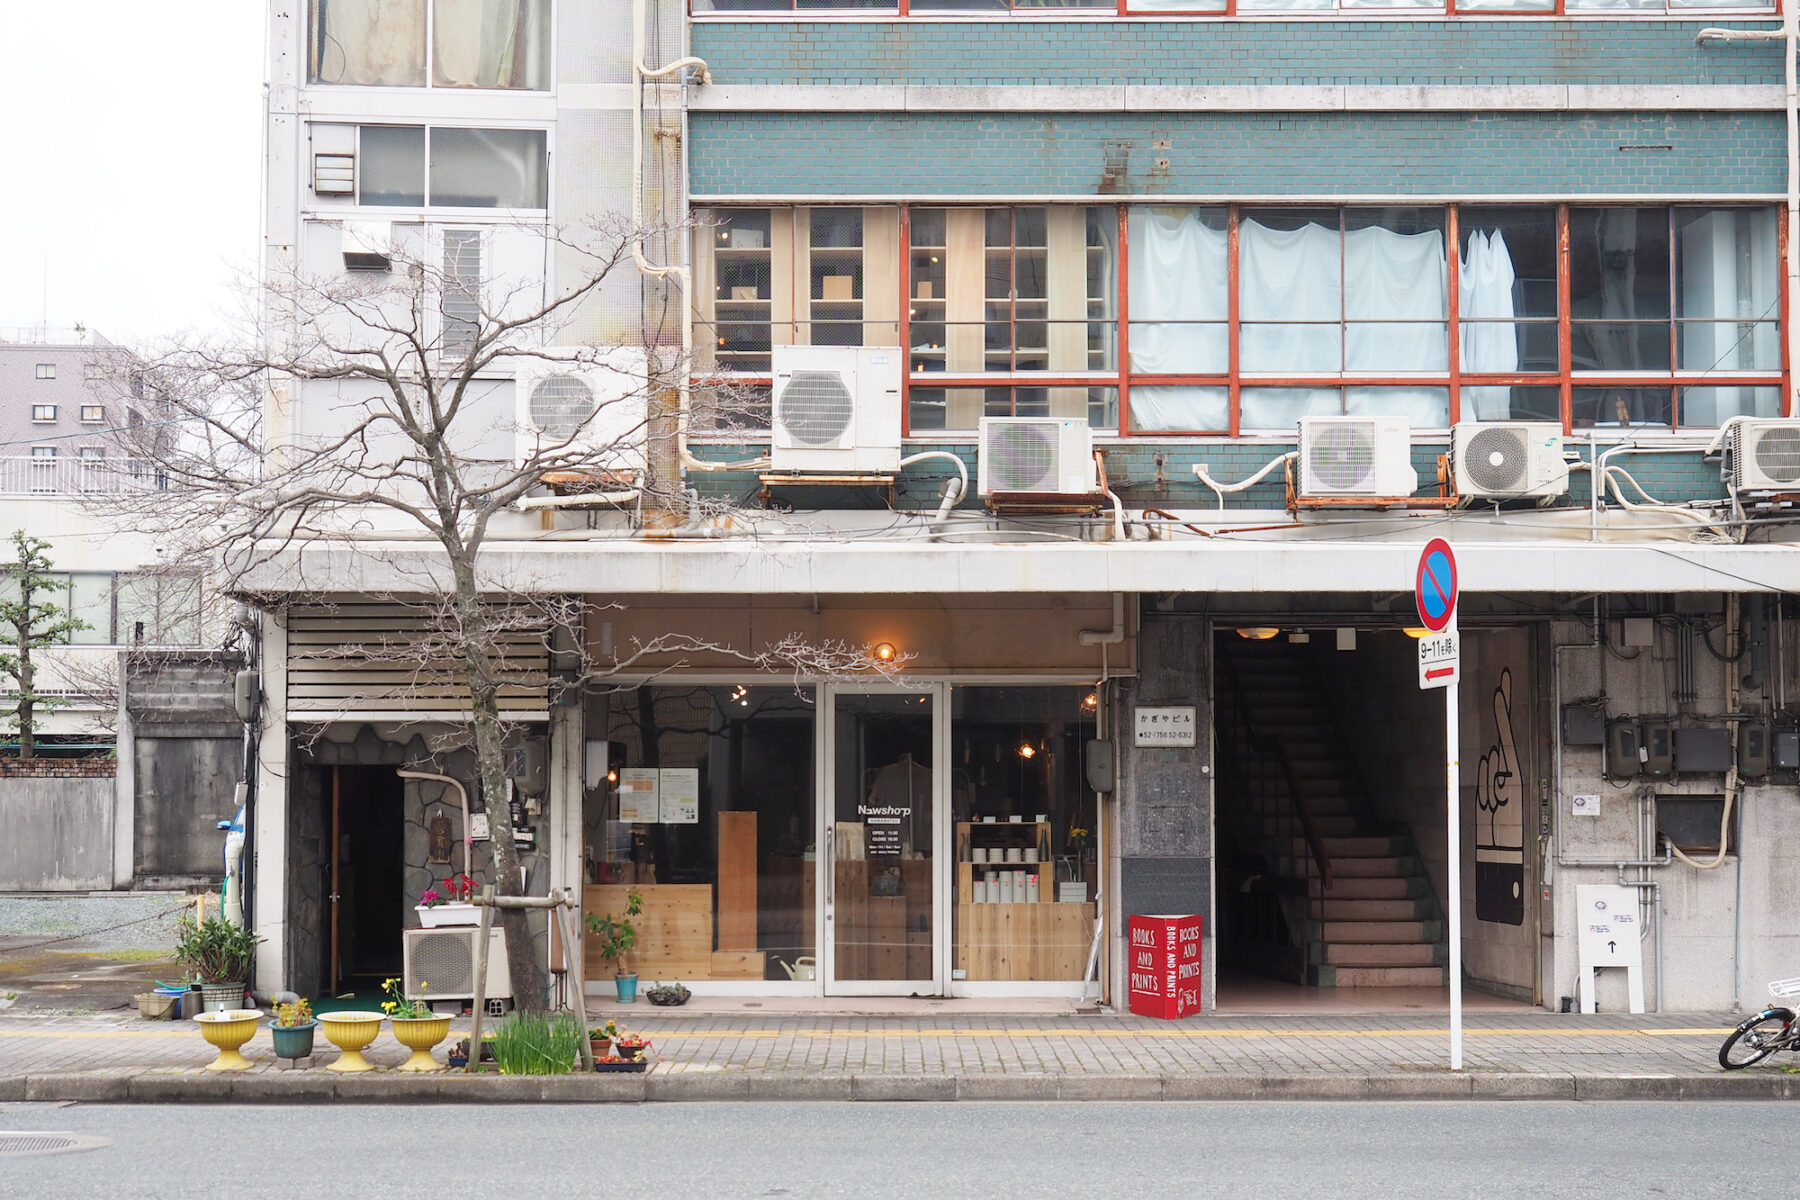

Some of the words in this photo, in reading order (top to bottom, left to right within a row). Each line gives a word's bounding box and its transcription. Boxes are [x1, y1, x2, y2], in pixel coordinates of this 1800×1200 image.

[1140, 714, 1190, 723] かぎやビル
[1132, 927, 1155, 945] BOOKS
[1166, 926, 1176, 951] BOOKS
[1179, 926, 1199, 943] BOOKS
[1137, 951, 1153, 966] AND
[1183, 943, 1197, 959] AND
[1166, 953, 1176, 969] AND
[1178, 961, 1200, 980] PRINTS
[1131, 972, 1158, 991] PRINTS
[1166, 970, 1176, 998] PRINTS
